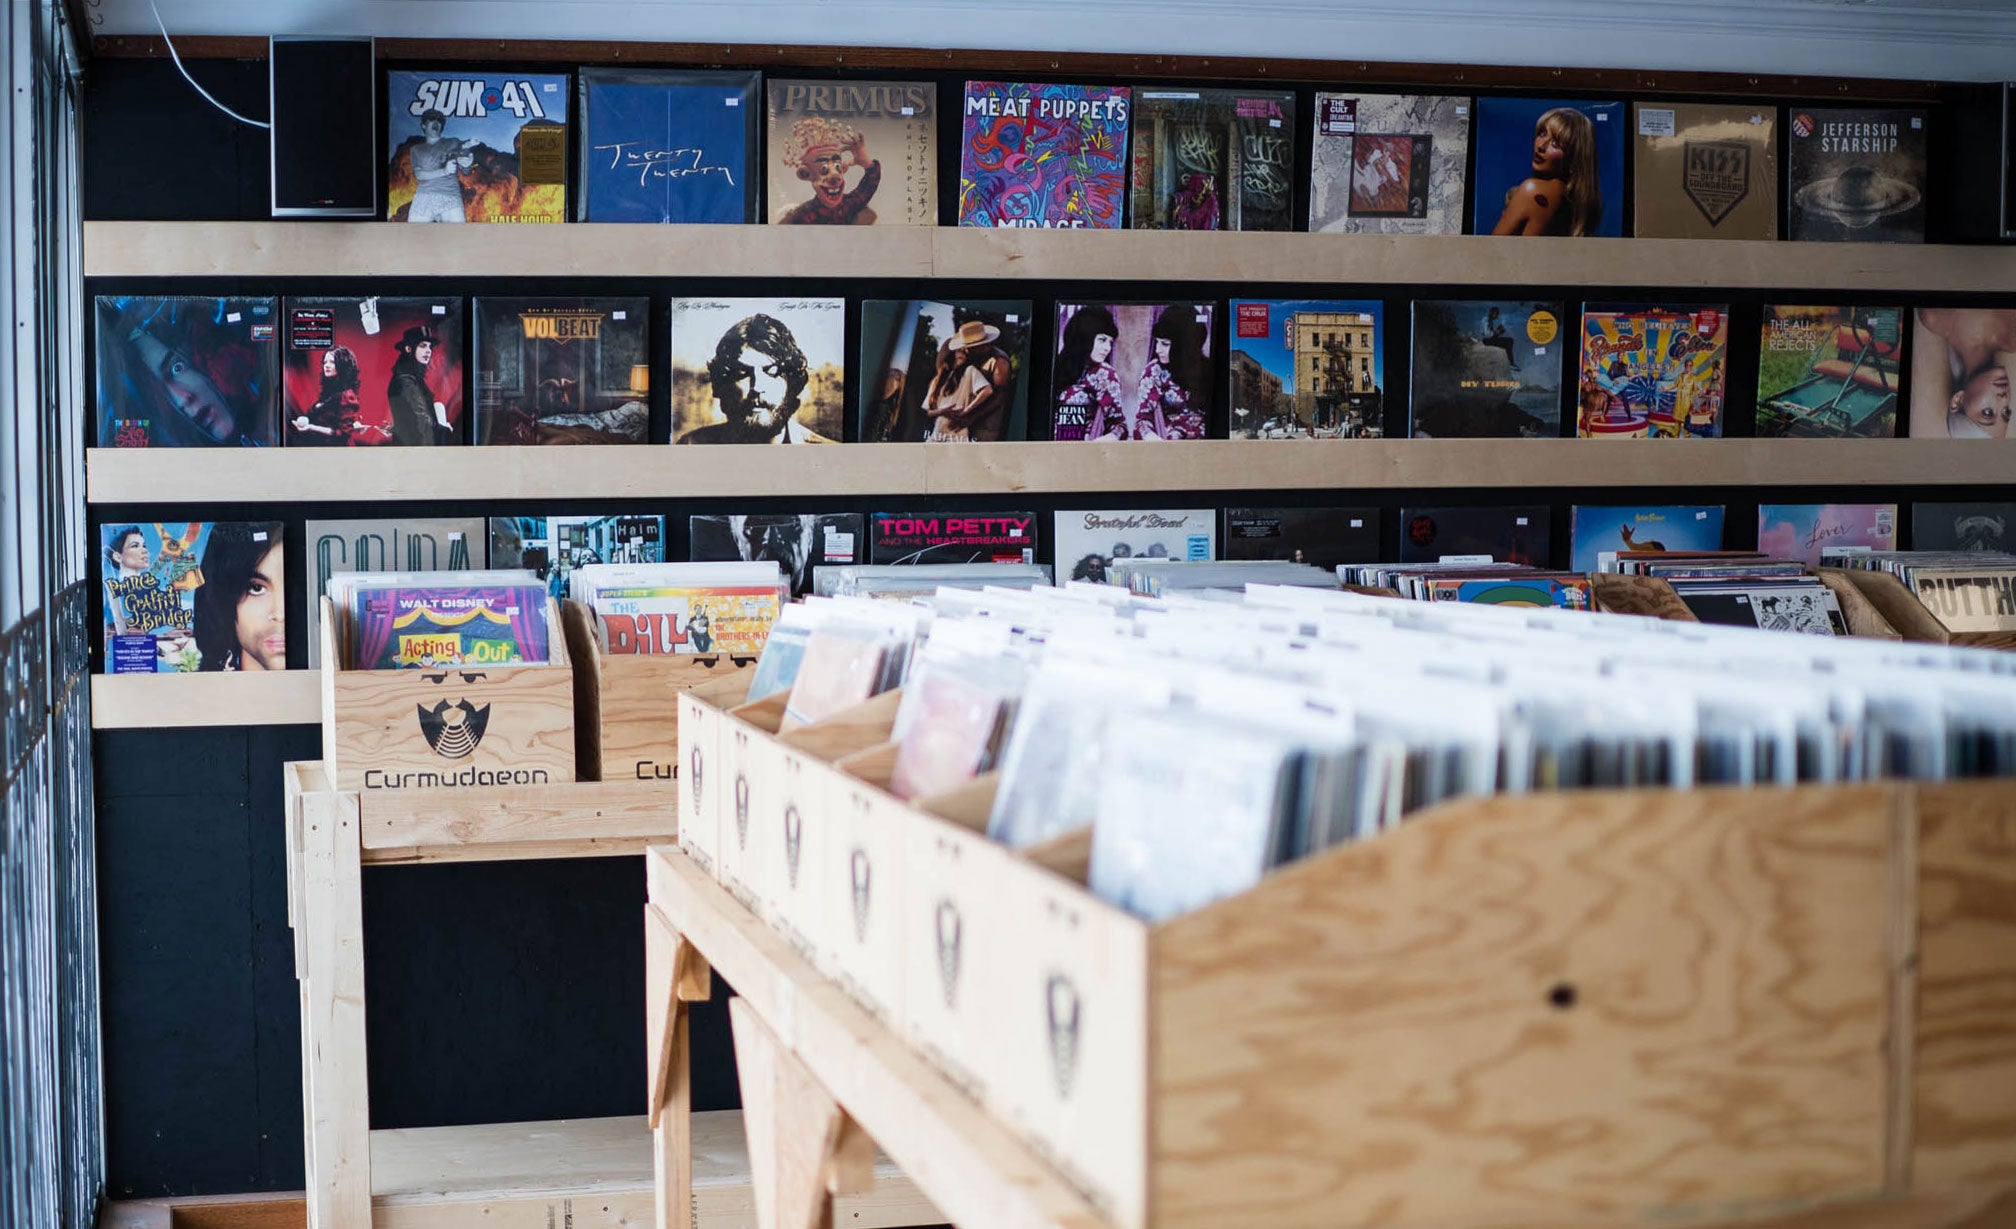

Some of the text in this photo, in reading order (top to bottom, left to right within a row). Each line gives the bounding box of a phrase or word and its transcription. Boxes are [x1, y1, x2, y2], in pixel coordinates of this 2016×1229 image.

[409, 79, 546, 118] SUM 41
[783, 84, 928, 115] PRIMUS
[967, 96, 1127, 122] MEAT PUPPETS
[1329, 106, 1348, 114] CULT
[1821, 123, 1898, 137] JEFFERSON
[1821, 138, 1898, 152] STARSHIP
[522, 317, 599, 339] VOLBEAT
[1769, 319, 1811, 330] THE ALL
[1769, 331, 1817, 340] AMERICAN
[1769, 340, 1816, 351] REJECTS
[1460, 380, 1479, 388] MY
[1058, 406, 1086, 415] OLIVIA
[1057, 414, 1086, 425] JEAN
[878, 518, 1031, 535] TOM PETTY
[1084, 513, 1188, 530] Grateful Dead
[926, 536, 1031, 544] HEARTBREAKERS
[1805, 519, 1855, 549] Lover
[106, 572, 160, 598] Prince
[400, 599, 439, 609] WALT
[441, 598, 495, 608] DISNEY
[1918, 577, 2016, 616] BUTTH
[610, 601, 640, 614] THE
[141, 608, 193, 633] Bridge
[715, 631, 769, 641] BROTHERS-IN-L
[403, 638, 511, 662] Acting Out
